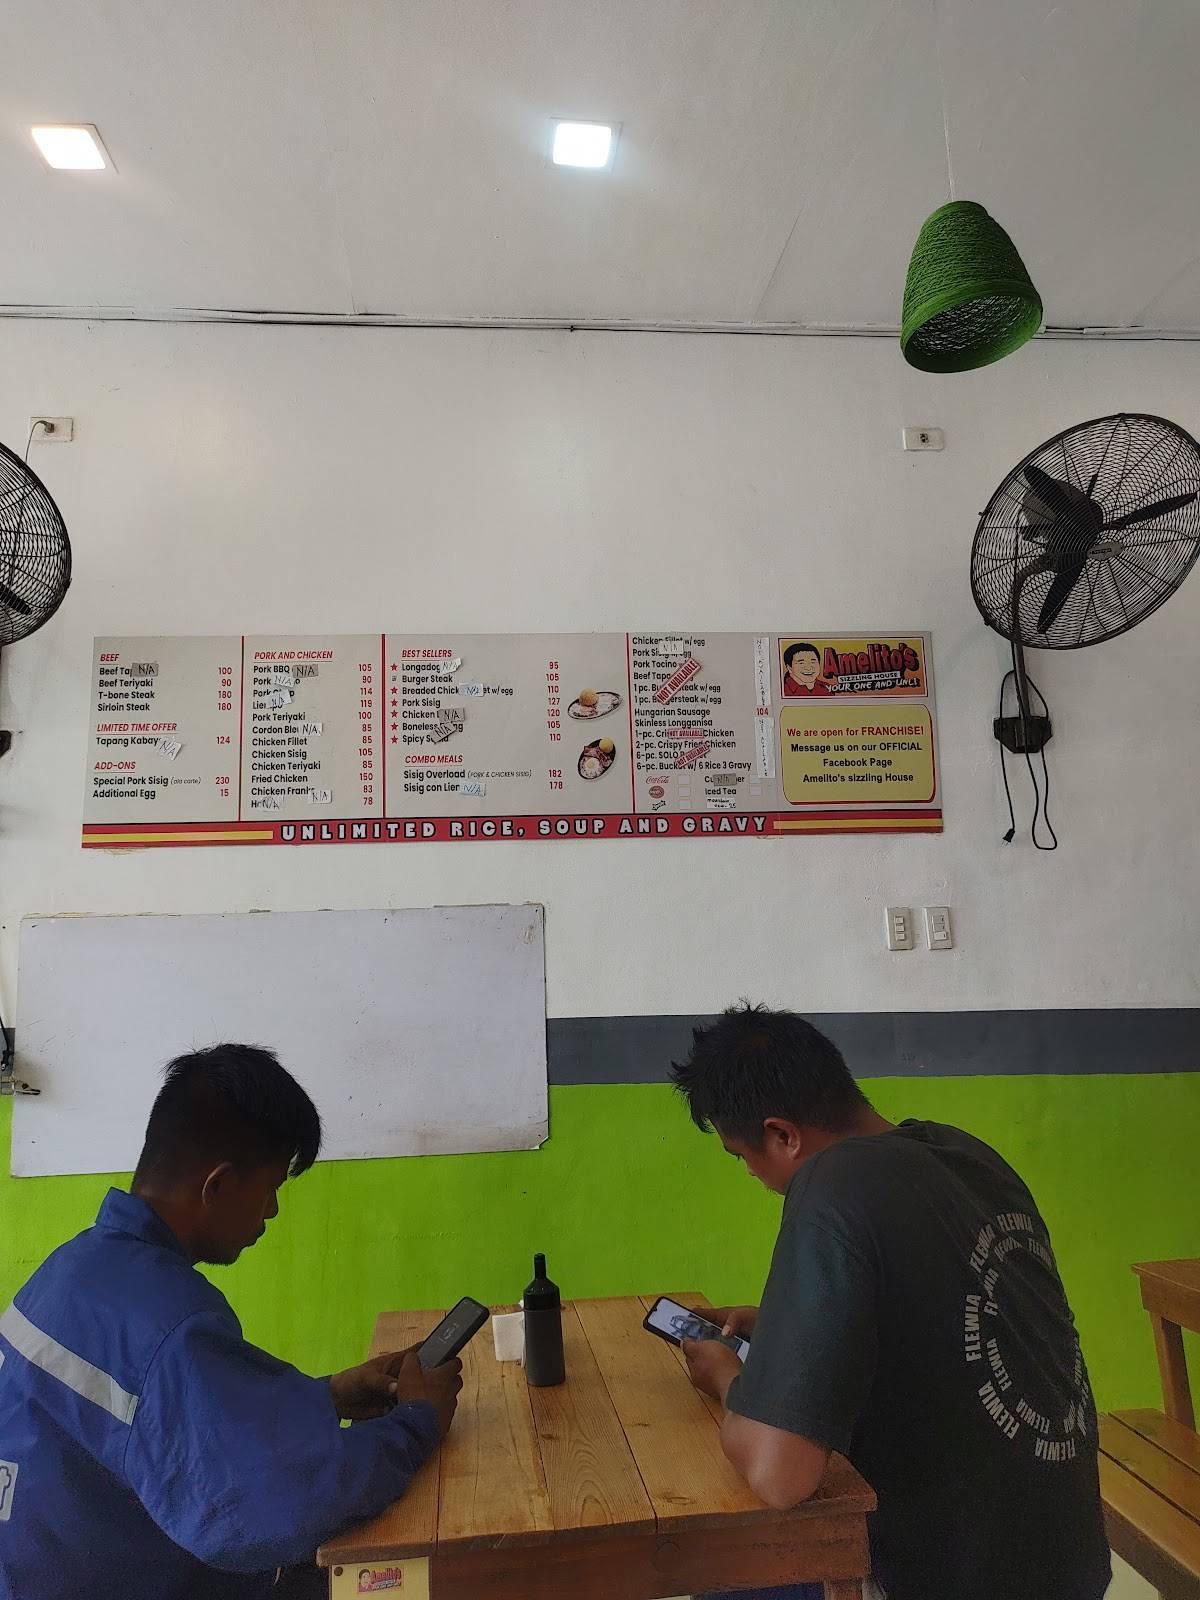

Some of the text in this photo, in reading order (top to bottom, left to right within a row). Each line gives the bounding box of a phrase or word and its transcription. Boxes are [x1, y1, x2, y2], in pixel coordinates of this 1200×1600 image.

[100, 653, 120, 662] BEEF
[254, 652, 276, 660] PORK
[297, 651, 333, 659] CHICKEN
[402, 650, 452, 658] BEST SELLERS
[633, 660, 650, 668] Pork
[823, 643, 919, 677] Amelito's
[99, 667, 232, 675] Beef 100
[138, 664, 155, 674] N/A
[273, 665, 290, 674] BBQ
[358, 664, 372, 672] 105
[297, 665, 314, 677] N/A
[253, 677, 271, 685] Pork
[402, 675, 429, 685] Burger
[430, 675, 453, 683] Steak
[633, 672, 650, 680] Beef
[99, 679, 118, 687] Beef
[120, 679, 153, 689] Teriyaki
[657, 661, 698, 703] NOT AVAILABLE
[826, 680, 892, 692] YOUR ONE AND
[402, 686, 436, 695] Breaded
[501, 688, 513, 696] egg
[639, 685, 650, 694] pc.
[99, 691, 130, 700] T-bone
[131, 691, 155, 699] Steak
[639, 696, 722, 705] pc. egg
[98, 702, 232, 711] Sirloin Steak 180
[402, 699, 420, 707] Pork
[421, 698, 441, 708] Sisig
[273, 712, 305, 723] Teriyaki
[358, 712, 372, 720] 100
[402, 709, 560, 719] Chicken 120
[634, 708, 710, 718] Hungarian Sausage
[97, 723, 177, 732] LIMITED TIME OFFER
[402, 722, 438, 731] Boneless
[547, 721, 561, 729] 105
[635, 719, 713, 728] Skinless Longganisa
[252, 726, 282, 734] Cordon
[302, 724, 318, 734] N/A
[635, 729, 734, 739] 1-pc. Chicken
[787, 728, 801, 736] We
[821, 729, 843, 738] open
[846, 728, 859, 736] for
[861, 726, 924, 736] FRANCHISE!
[96, 737, 231, 747] Tapang 124
[252, 738, 286, 746] Chicken
[287, 737, 307, 745] Fillet
[402, 734, 424, 745] Spicy
[160, 740, 177, 756] N/A
[636, 740, 736, 750] 2-pc. Crispy Chicken
[791, 744, 831, 753] Message
[879, 743, 922, 751] OFFICIAL
[252, 748, 373, 760] Chicken Sisig 105
[659, 751, 678, 759] SOLO
[677, 756, 687, 766] NOT
[686, 745, 710, 761] AVAILABLE
[405, 755, 463, 764] COMBO MEALS
[823, 758, 893, 768] Facebook Page
[94, 762, 136, 770] ADD-ONS
[252, 762, 286, 771] Chicken
[288, 761, 321, 772] Teriyaki
[637, 763, 658, 772] 6-pc.
[723, 761, 726, 769] 3
[728, 761, 752, 771] Gravy
[251, 773, 373, 783] Fried Chicken 150
[404, 770, 424, 781] Sisig
[425, 770, 466, 779] Overload
[548, 769, 562, 777] 182
[803, 773, 914, 783] Amelito's sizzling House
[93, 776, 230, 787] Special Pork Sisig 230
[251, 785, 373, 795] Chicken 83
[404, 783, 424, 794] Sisig
[426, 784, 441, 792] con
[705, 787, 737, 795] Iced Tea
[93, 789, 229, 800] Additional Egg 15
[312, 791, 328, 801] N/A
[363, 797, 373, 805] 78
[280, 816, 766, 841] UNLIMITED RICE, SOUP AND GRAVY
[996, 1213, 1033, 1233] FLEWIA
[970, 1224, 995, 1274] FLEWIA
[964, 1294, 981, 1362] FLEWIA
[987, 1338, 1012, 1391] FLEWIA
[978, 1380, 1021, 1439] FLEWIA
[1016, 1398, 1050, 1434] FLEWIA
[1034, 1437, 1076, 1461] FLEWIA
